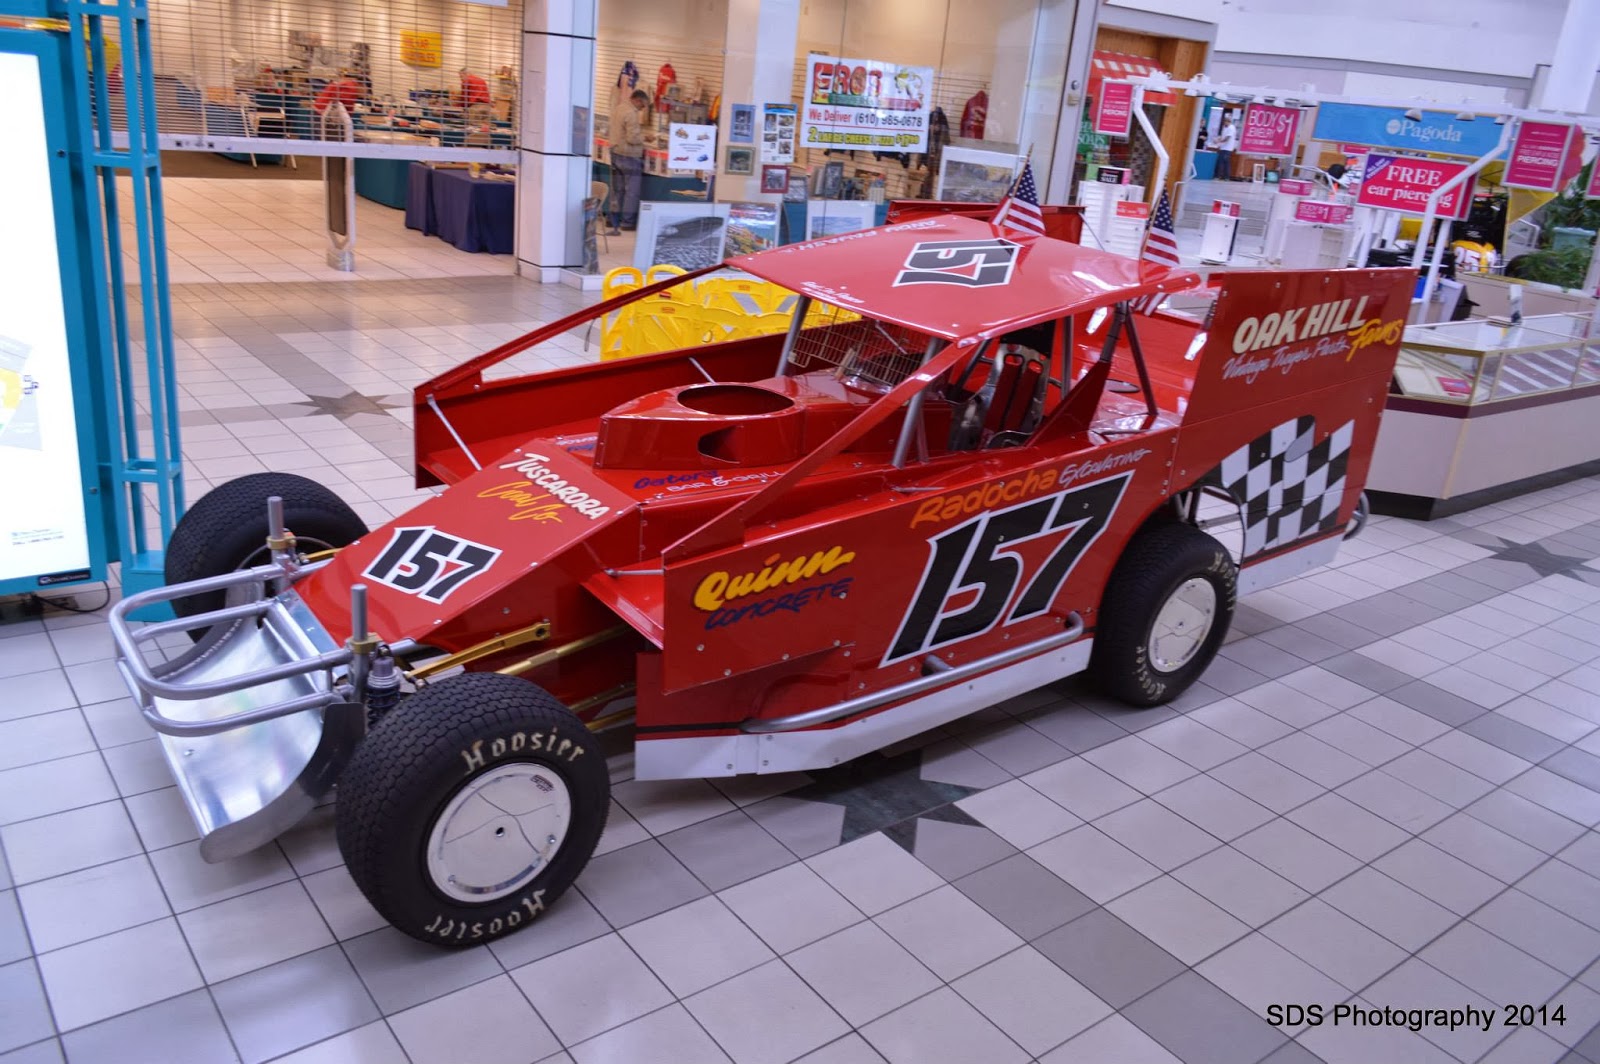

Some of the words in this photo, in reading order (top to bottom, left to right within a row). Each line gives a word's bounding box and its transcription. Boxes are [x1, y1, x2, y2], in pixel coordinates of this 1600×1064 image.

[807, 126, 818, 142] 2
[808, 108, 822, 120] We
[824, 109, 852, 123] Deliver
[855, 112, 879, 126] (610)
[1399, 119, 1462, 142] Pagoda
[1367, 184, 1392, 196] ear
[1386, 165, 1442, 187] FREE
[892, 238, 1025, 289] 157
[1232, 307, 1305, 354] OAK
[1300, 295, 1370, 340] HILL
[499, 453, 610, 520] TUSCARORA
[711, 475, 733, 487] &
[910, 469, 1058, 529] Radocha
[360, 525, 504, 605] 157
[693, 545, 856, 612] Quinn
[879, 469, 1136, 669] 157
[461, 726, 585, 776] Hoosier
[424, 888, 547, 940] Hoosier
